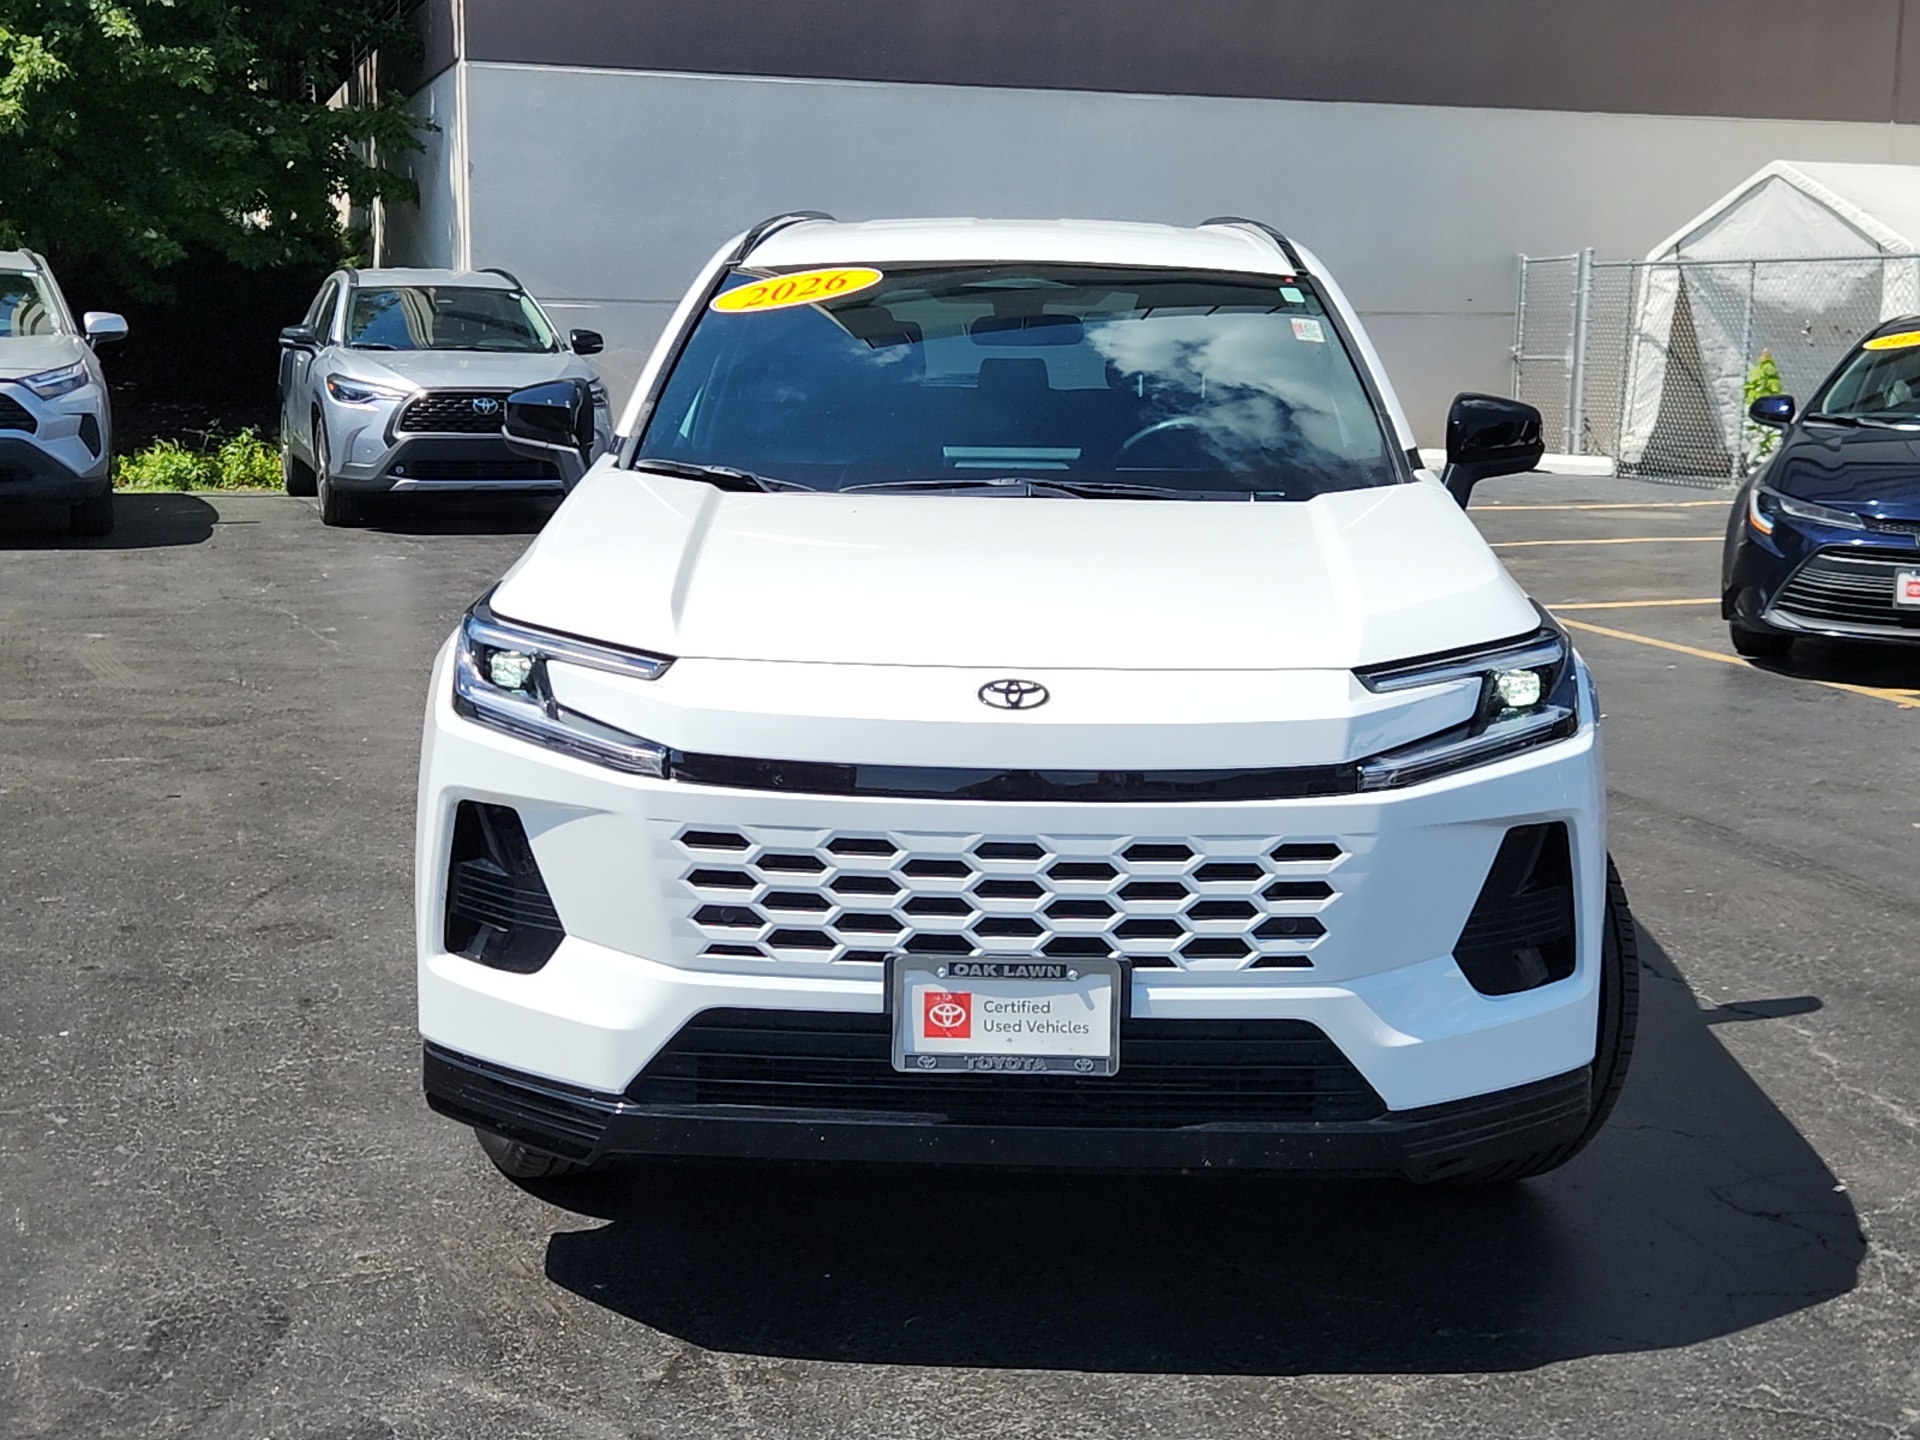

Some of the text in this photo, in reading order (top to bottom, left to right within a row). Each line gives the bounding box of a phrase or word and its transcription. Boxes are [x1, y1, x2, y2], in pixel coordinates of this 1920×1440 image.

[741, 271, 849, 308] 2026
[954, 963, 1062, 978] OAK LAWN
[983, 1000, 1051, 1014] Certified
[983, 1019, 1089, 1034] Used Vehicles
[963, 1055, 1048, 1071] TOYOTA
